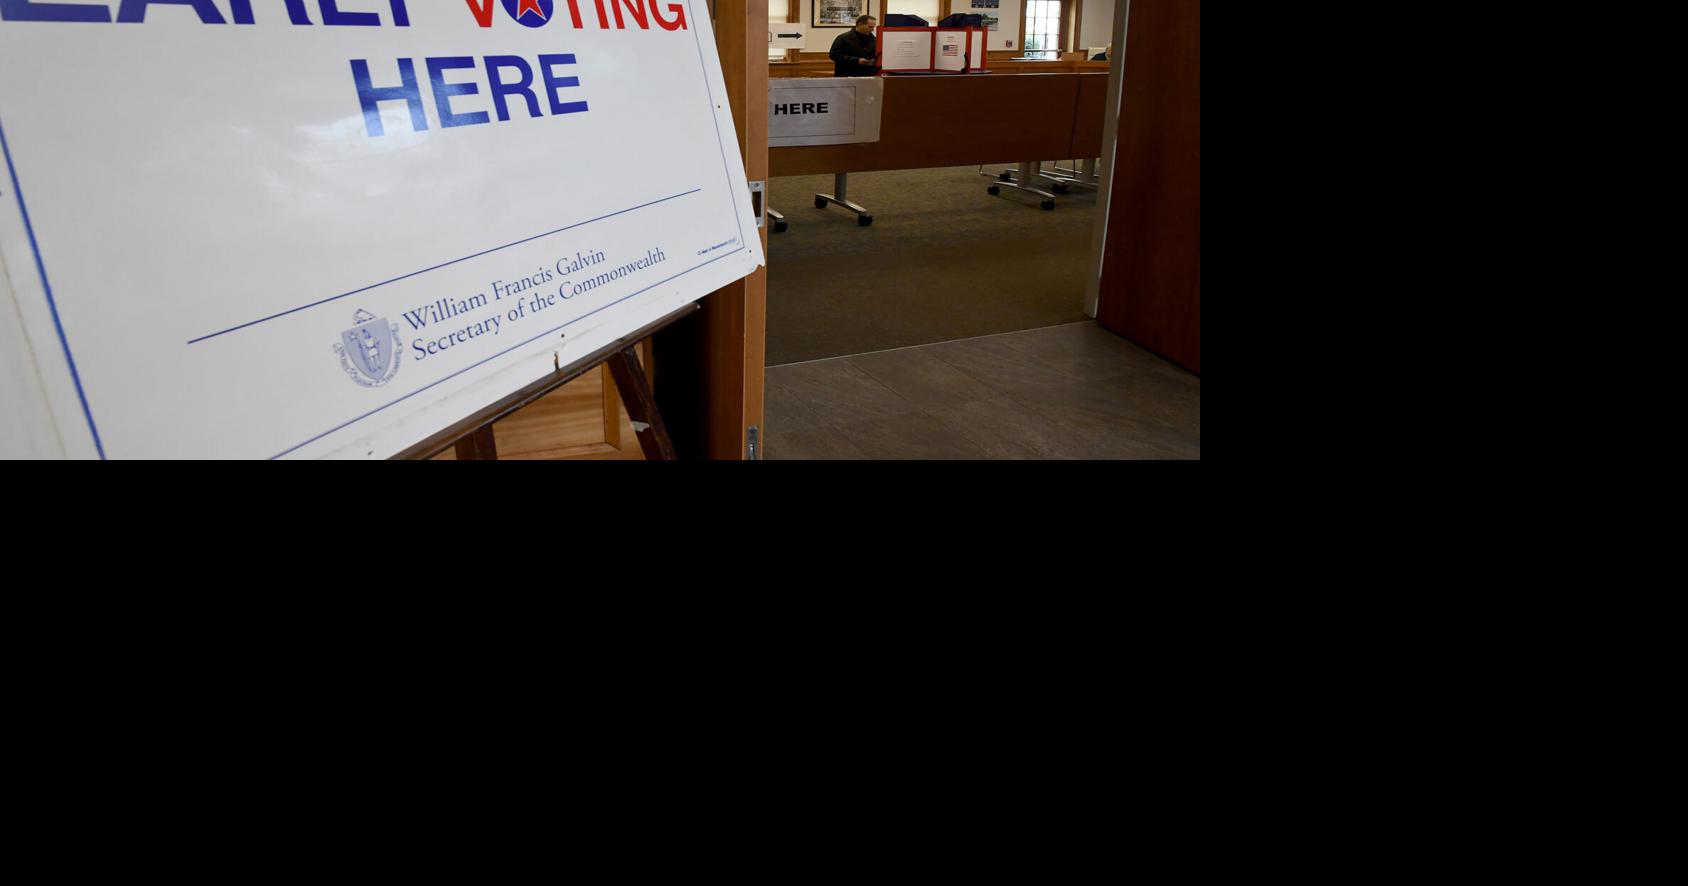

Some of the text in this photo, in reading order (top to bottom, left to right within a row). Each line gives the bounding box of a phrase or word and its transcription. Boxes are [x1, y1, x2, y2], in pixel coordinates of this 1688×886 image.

[349, 53, 589, 137] HERE
[774, 102, 829, 115] HERE
[402, 248, 606, 331] William Francis Galvin
[411, 313, 501, 361] Secretary
[507, 297, 526, 322] of
[529, 292, 556, 314] the
[559, 246, 667, 300] Commonwealth
